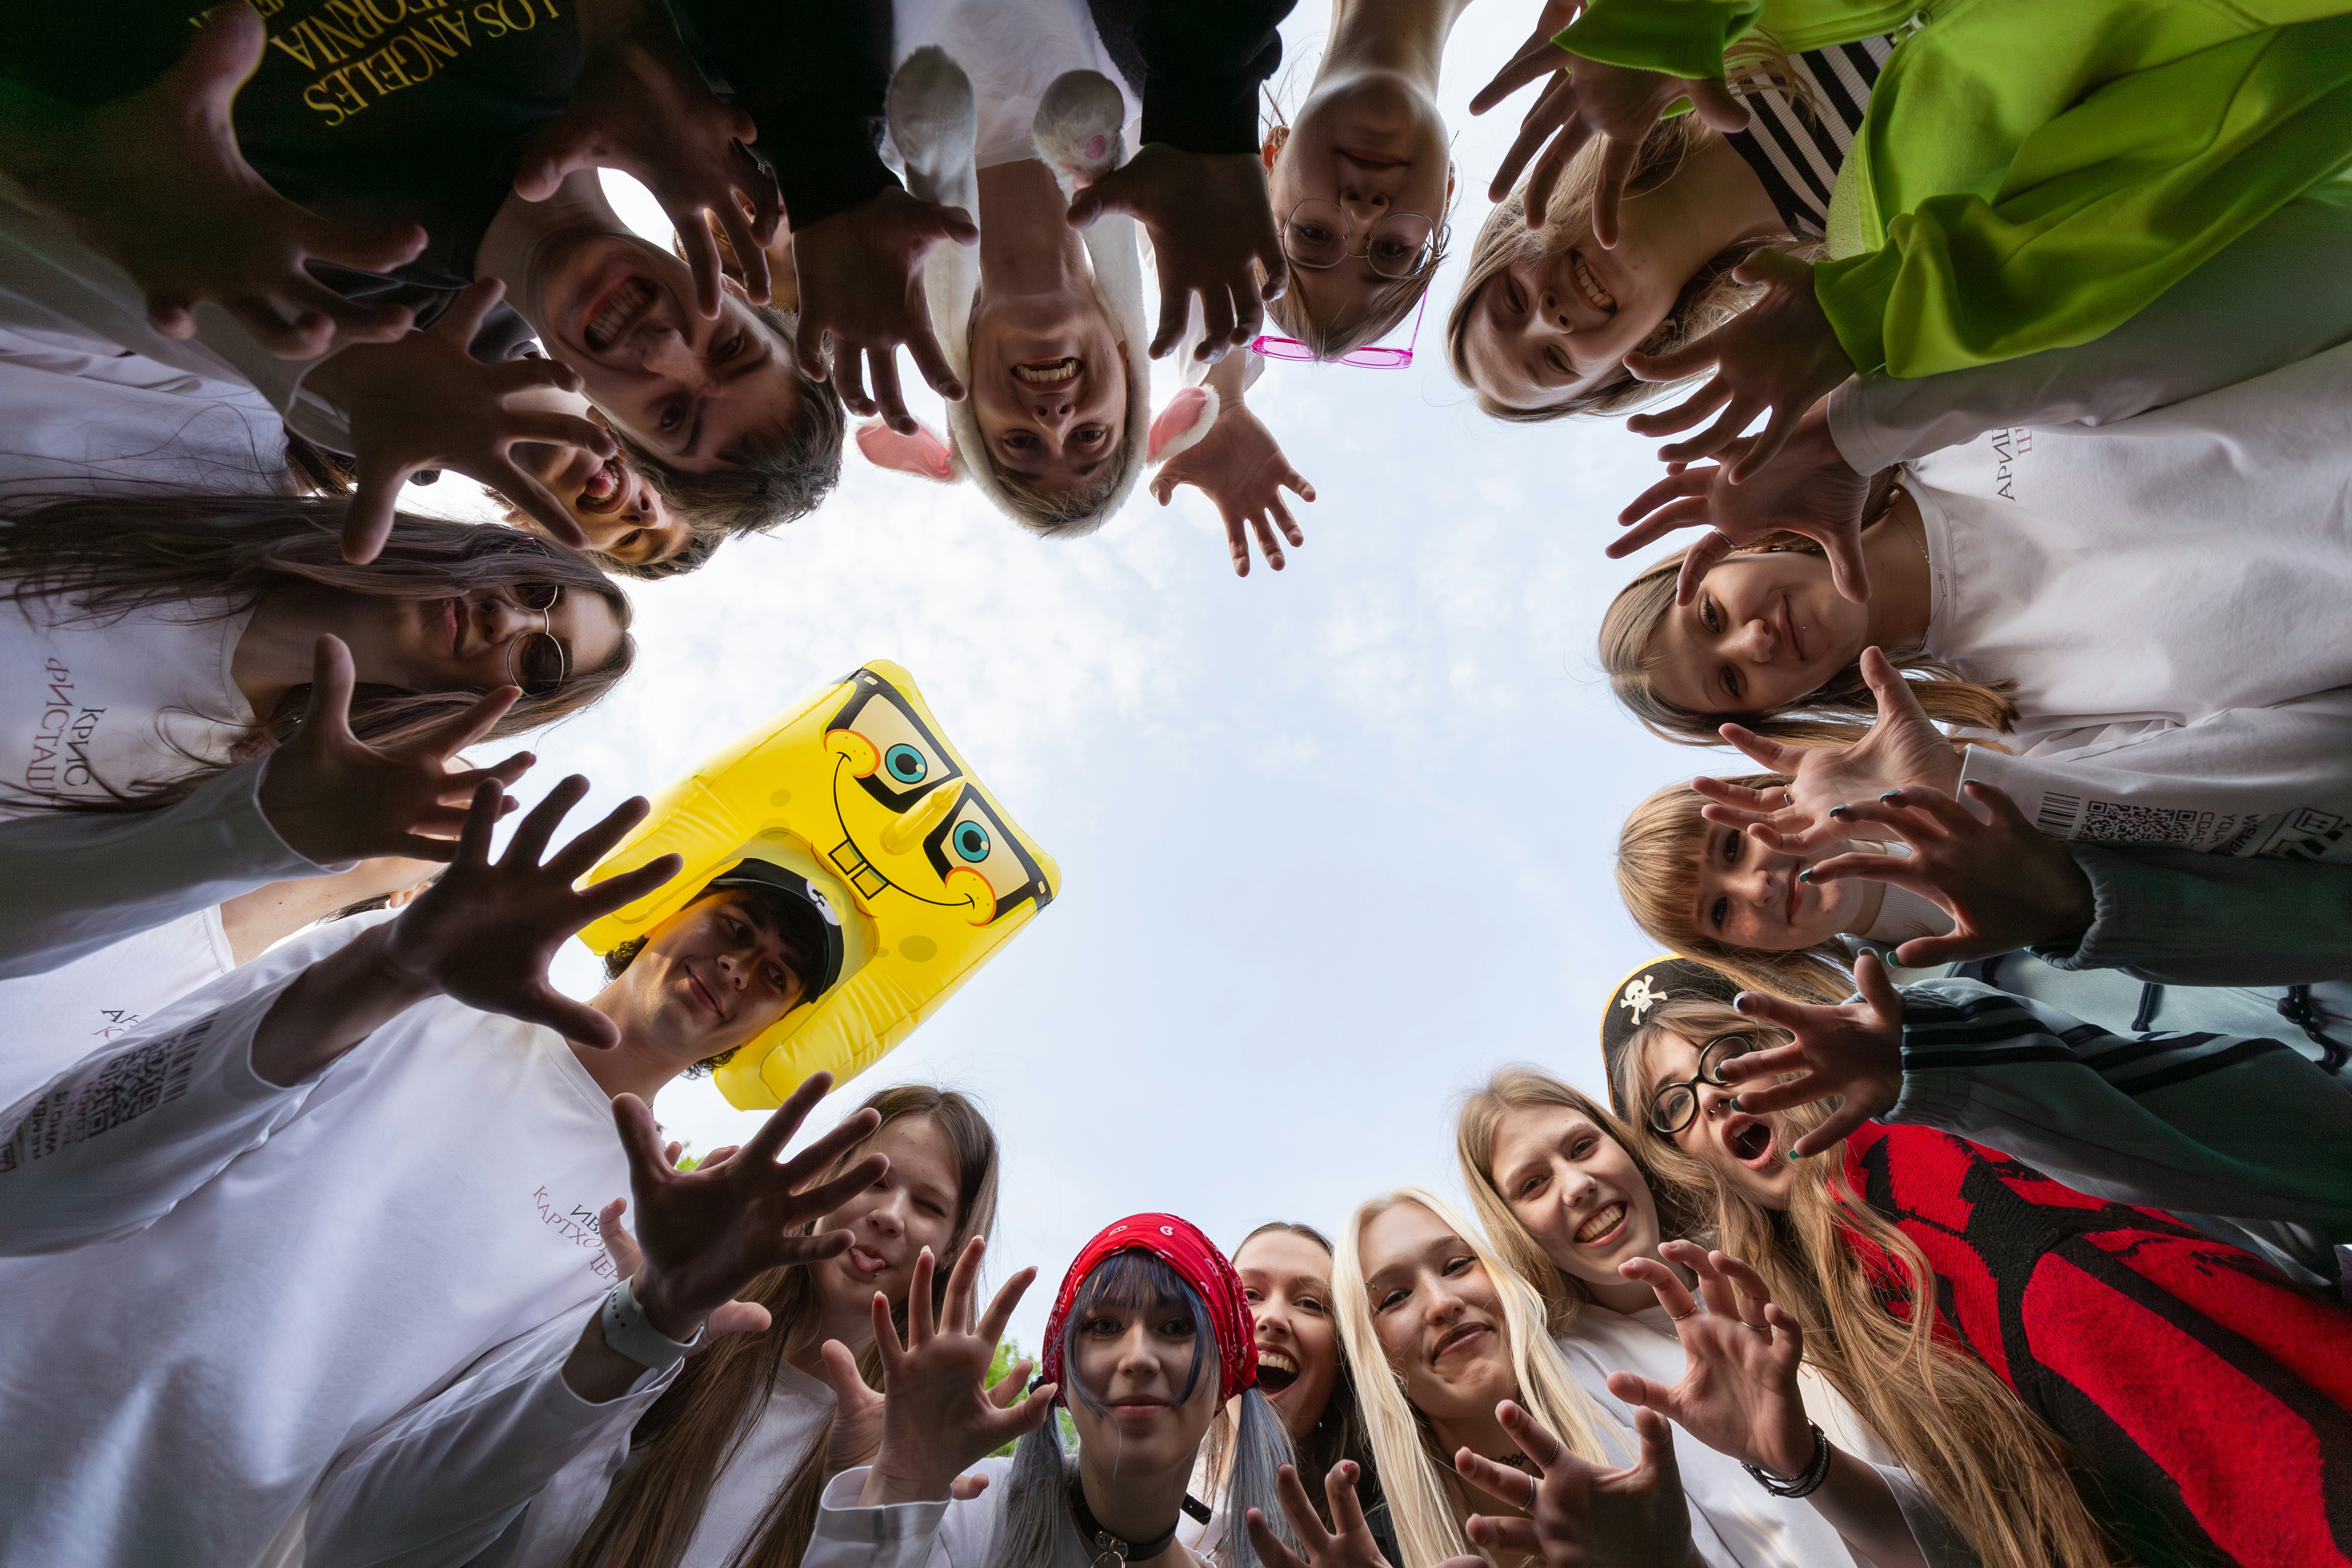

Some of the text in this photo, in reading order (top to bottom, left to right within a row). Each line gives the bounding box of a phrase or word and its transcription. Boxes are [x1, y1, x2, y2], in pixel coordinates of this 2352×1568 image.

[303, 9, 472, 126] ANGELES
[25, 658, 74, 791] ФИСТАШ
[63, 707, 107, 786] КРИС
